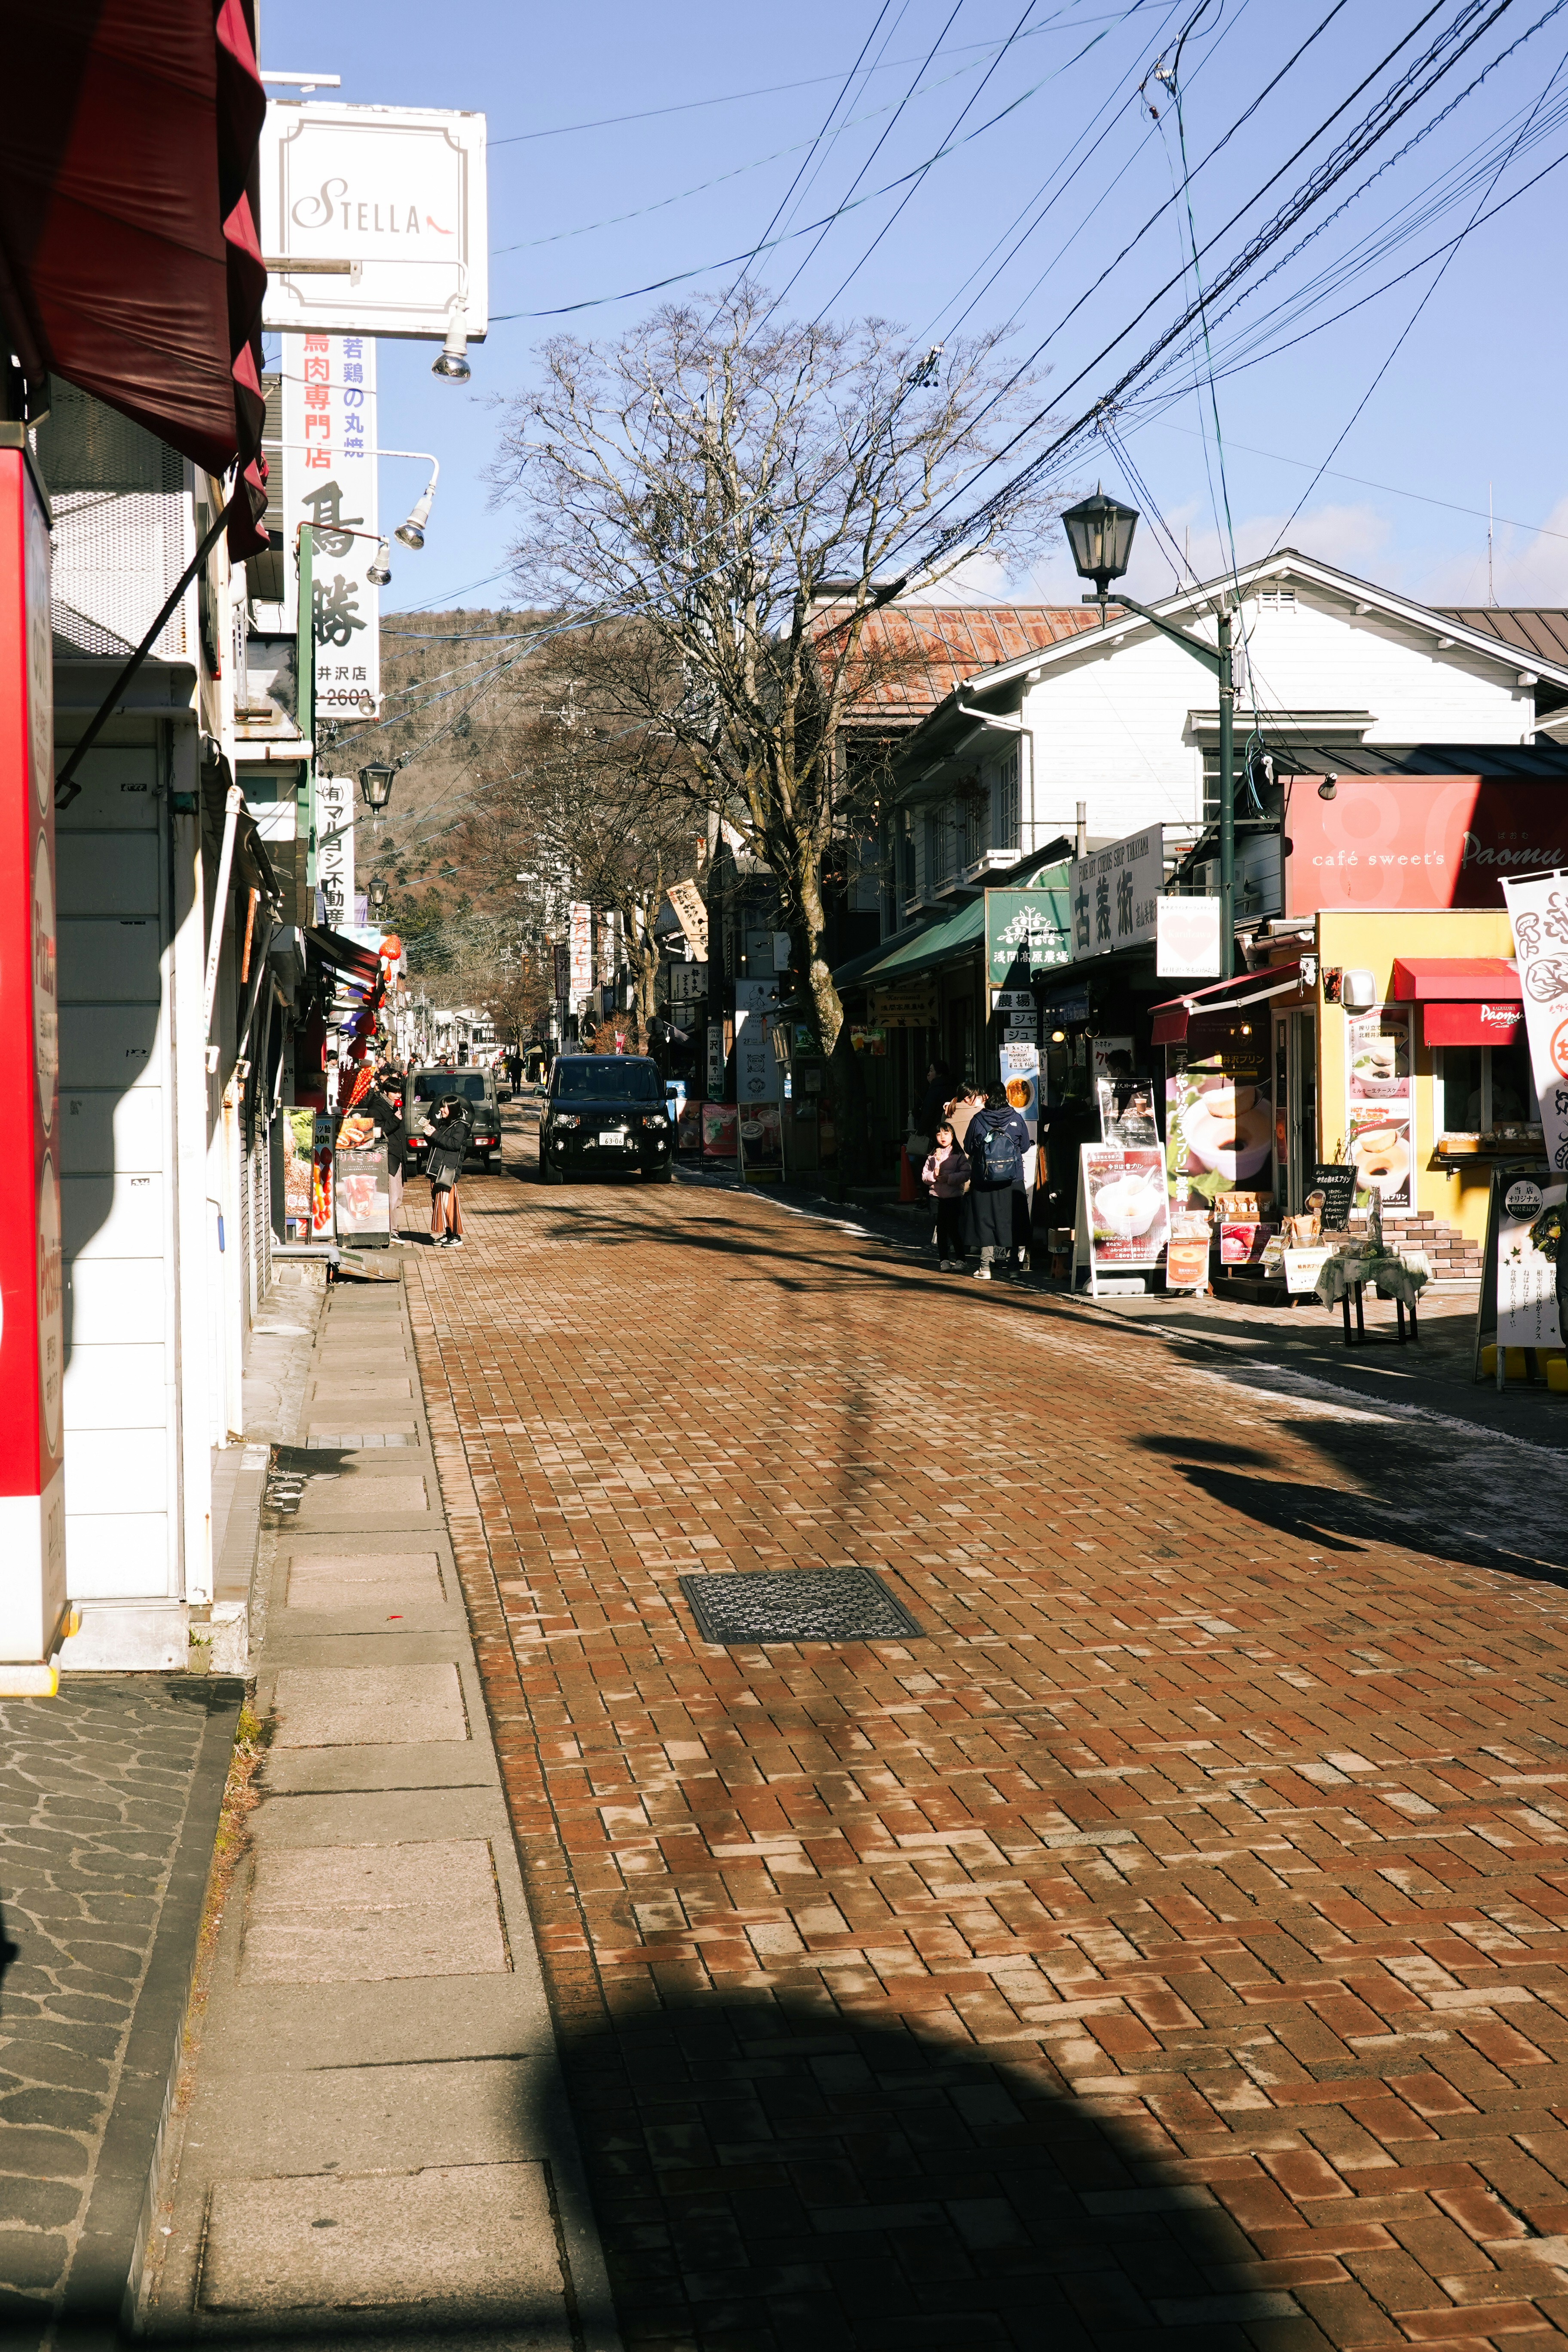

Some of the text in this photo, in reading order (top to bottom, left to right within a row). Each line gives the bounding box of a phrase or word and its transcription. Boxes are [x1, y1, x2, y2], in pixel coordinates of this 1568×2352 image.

[1078, 864, 1089, 883] FINE
[1097, 852, 1113, 873] CURIOS
[1114, 846, 1125, 867] SHOP
[1126, 836, 1149, 863] TAKAYAMA
[315, 1124, 331, 1133] ツ飴
